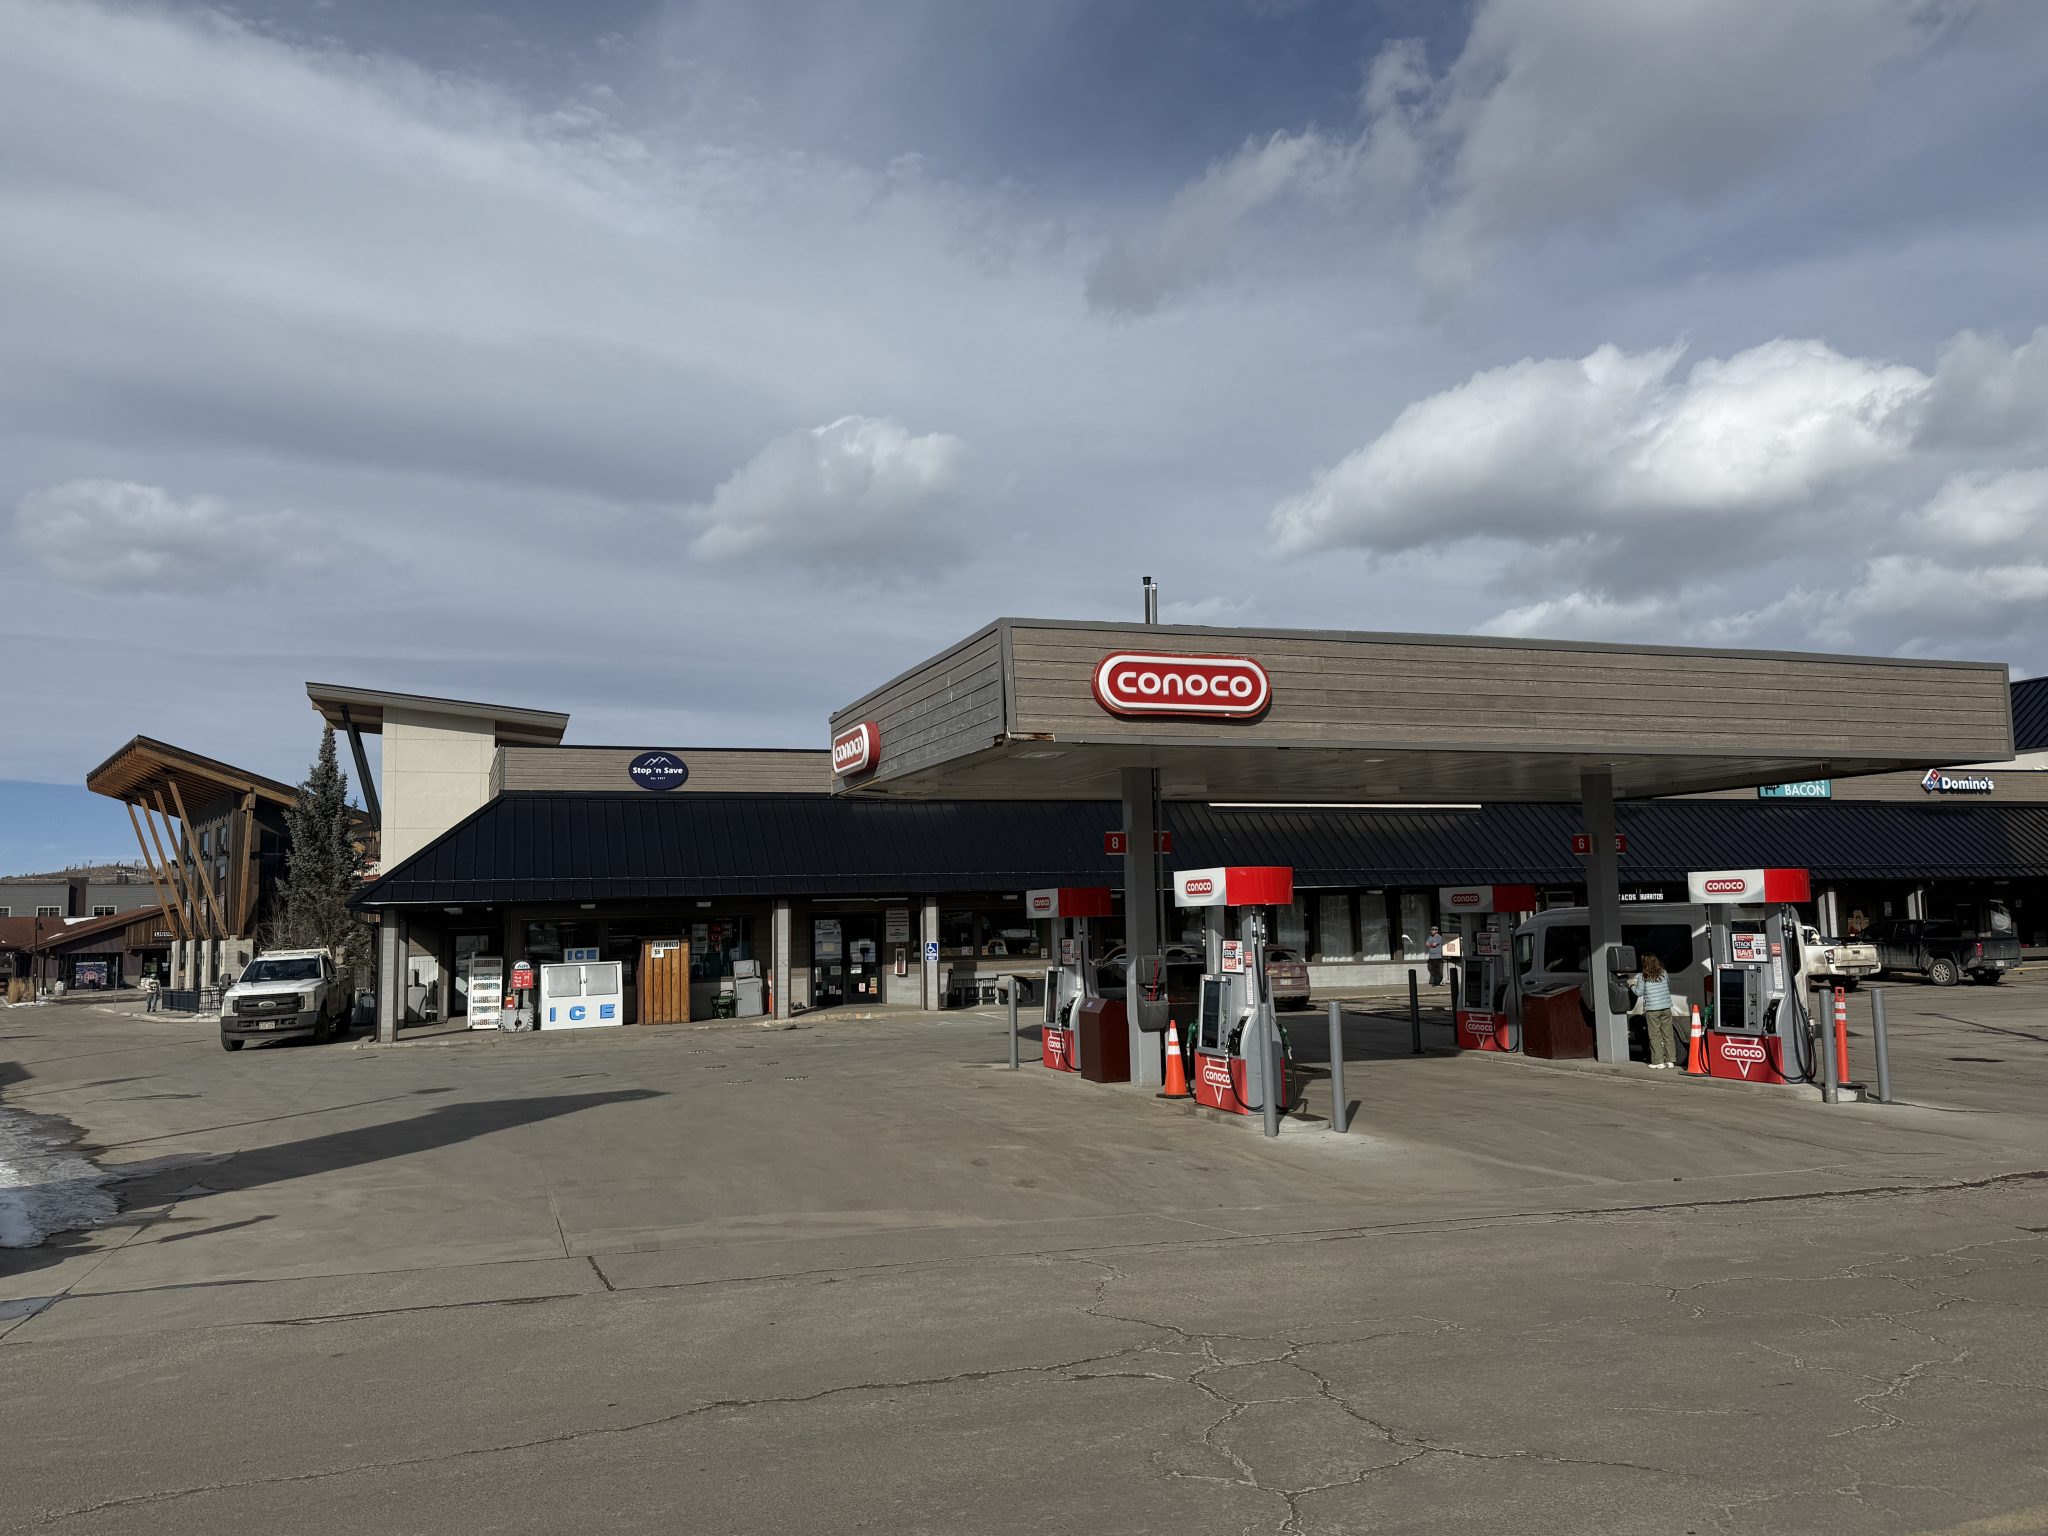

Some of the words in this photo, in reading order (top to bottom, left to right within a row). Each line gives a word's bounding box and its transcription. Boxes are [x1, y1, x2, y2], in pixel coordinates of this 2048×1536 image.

[632, 766, 652, 776] Stop
[1941, 776, 1995, 790] Domino's
[1784, 784, 1826, 796] BACON
[1111, 836, 1119, 849] 8
[1578, 838, 1585, 849] 6
[567, 949, 597, 960] ICE
[1736, 949, 1753, 957] SAVE
[1227, 978, 1232, 986] 8
[549, 1003, 616, 1022] ICE
